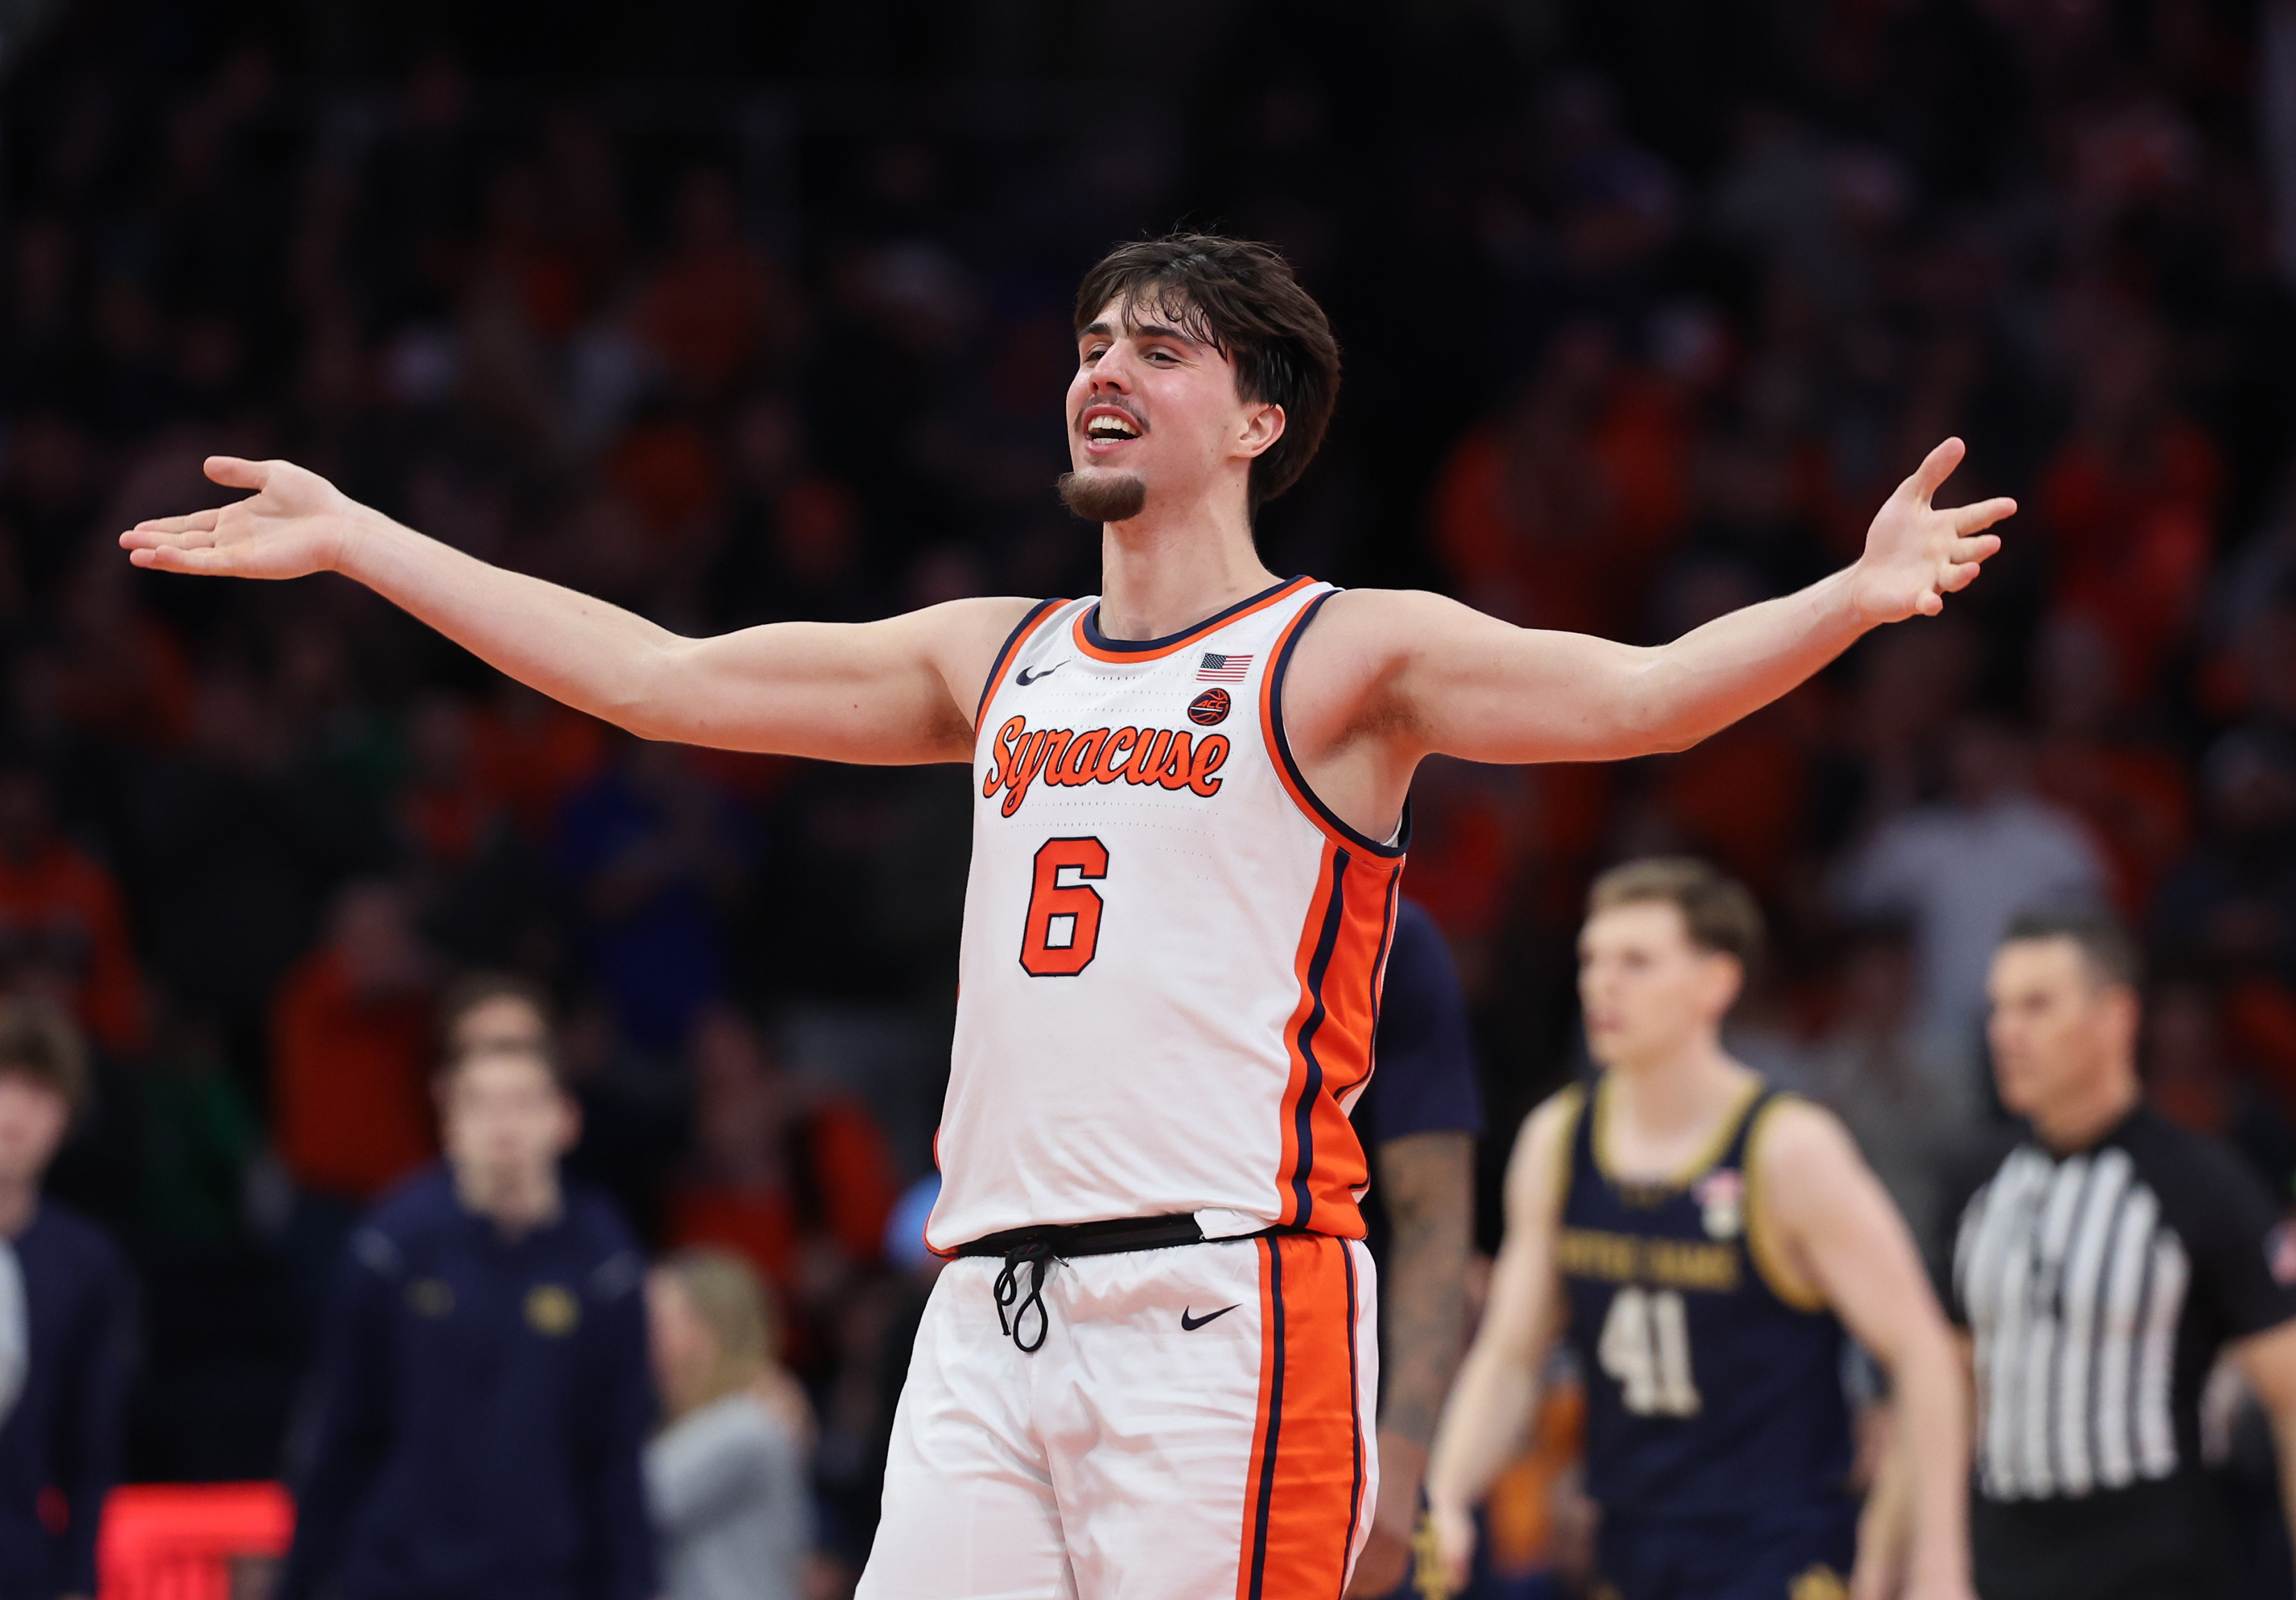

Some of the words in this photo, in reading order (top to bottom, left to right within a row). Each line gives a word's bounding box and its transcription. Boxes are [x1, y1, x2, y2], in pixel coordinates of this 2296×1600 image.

[1195, 700, 1228, 710] ACC
[983, 715, 1230, 818] Syracuse
[1019, 836, 1109, 977] 6
[1598, 1286, 1701, 1416] 41
